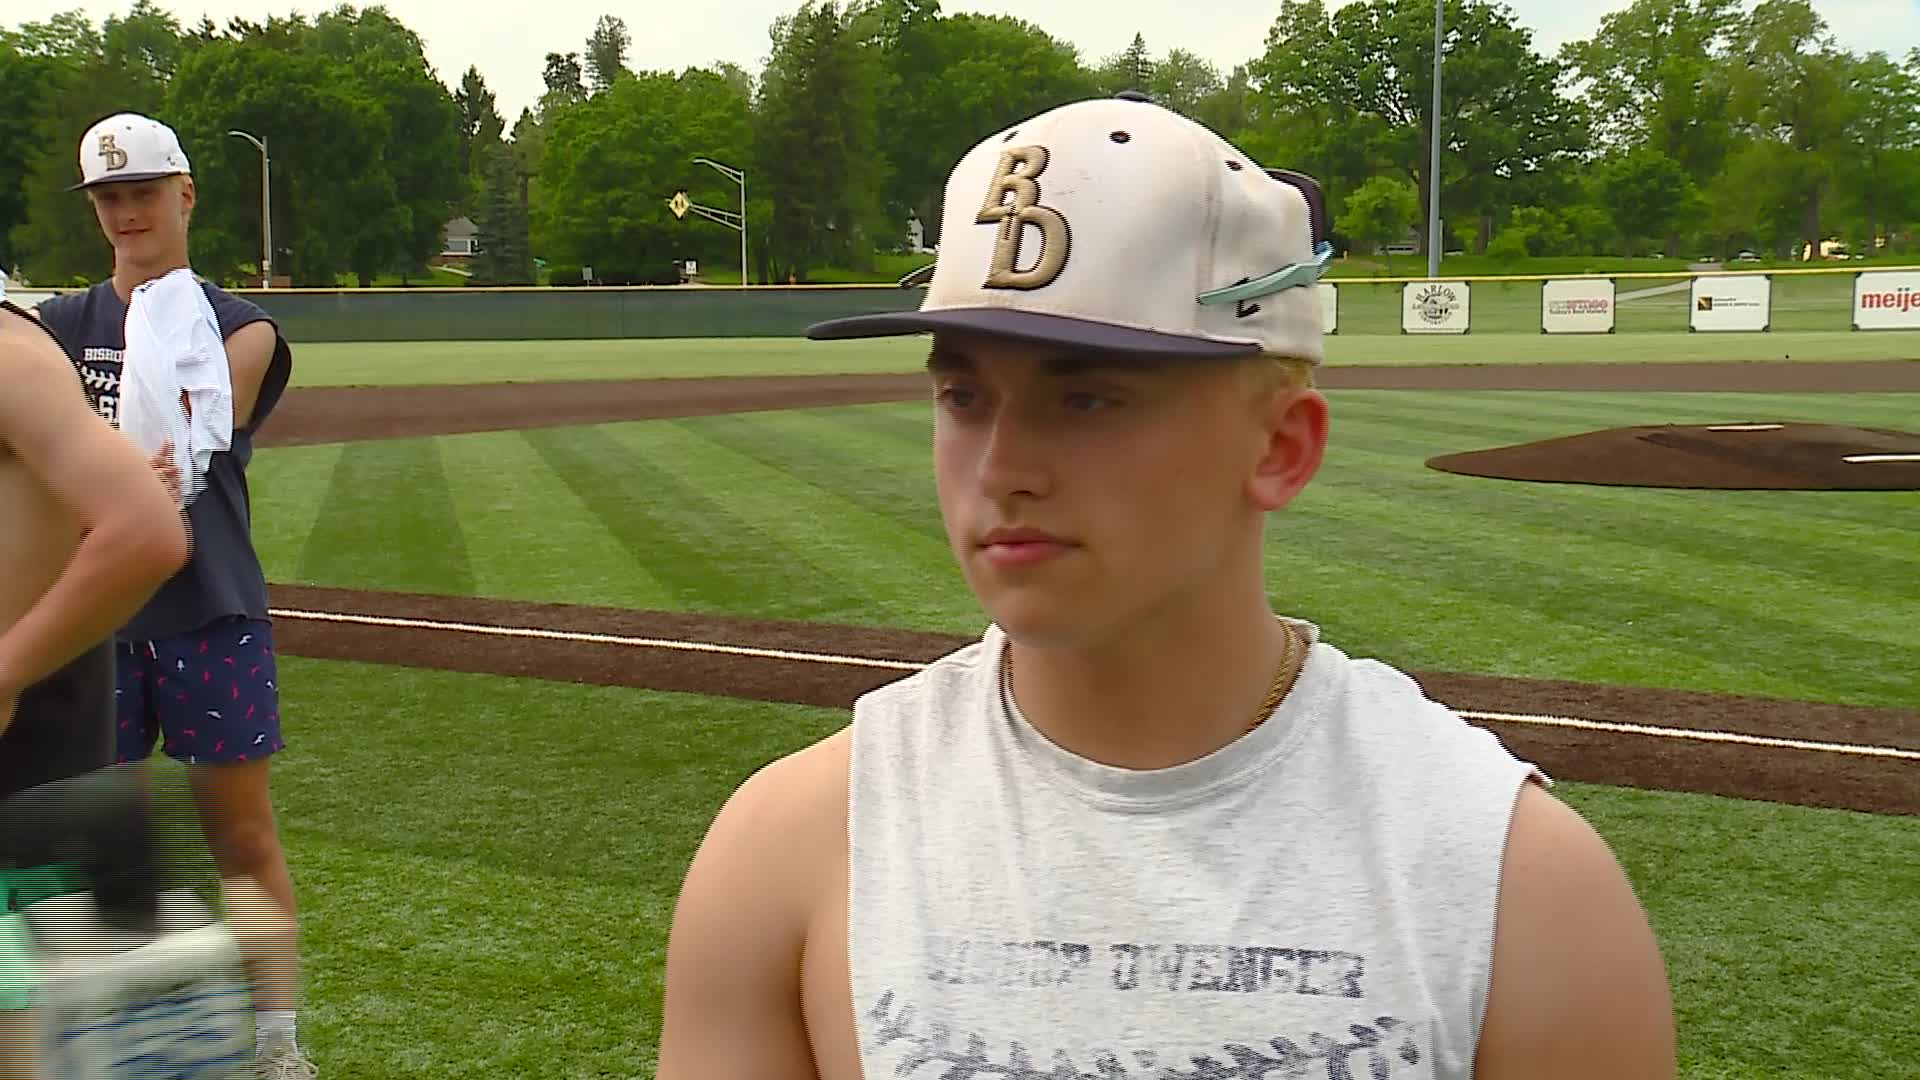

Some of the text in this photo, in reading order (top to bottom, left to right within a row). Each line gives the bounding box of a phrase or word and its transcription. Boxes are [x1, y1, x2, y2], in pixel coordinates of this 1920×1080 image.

[1415, 285, 1457, 302] HARLOW
[1861, 287, 1920, 312] meije
[84, 348, 123, 362] BISHO
